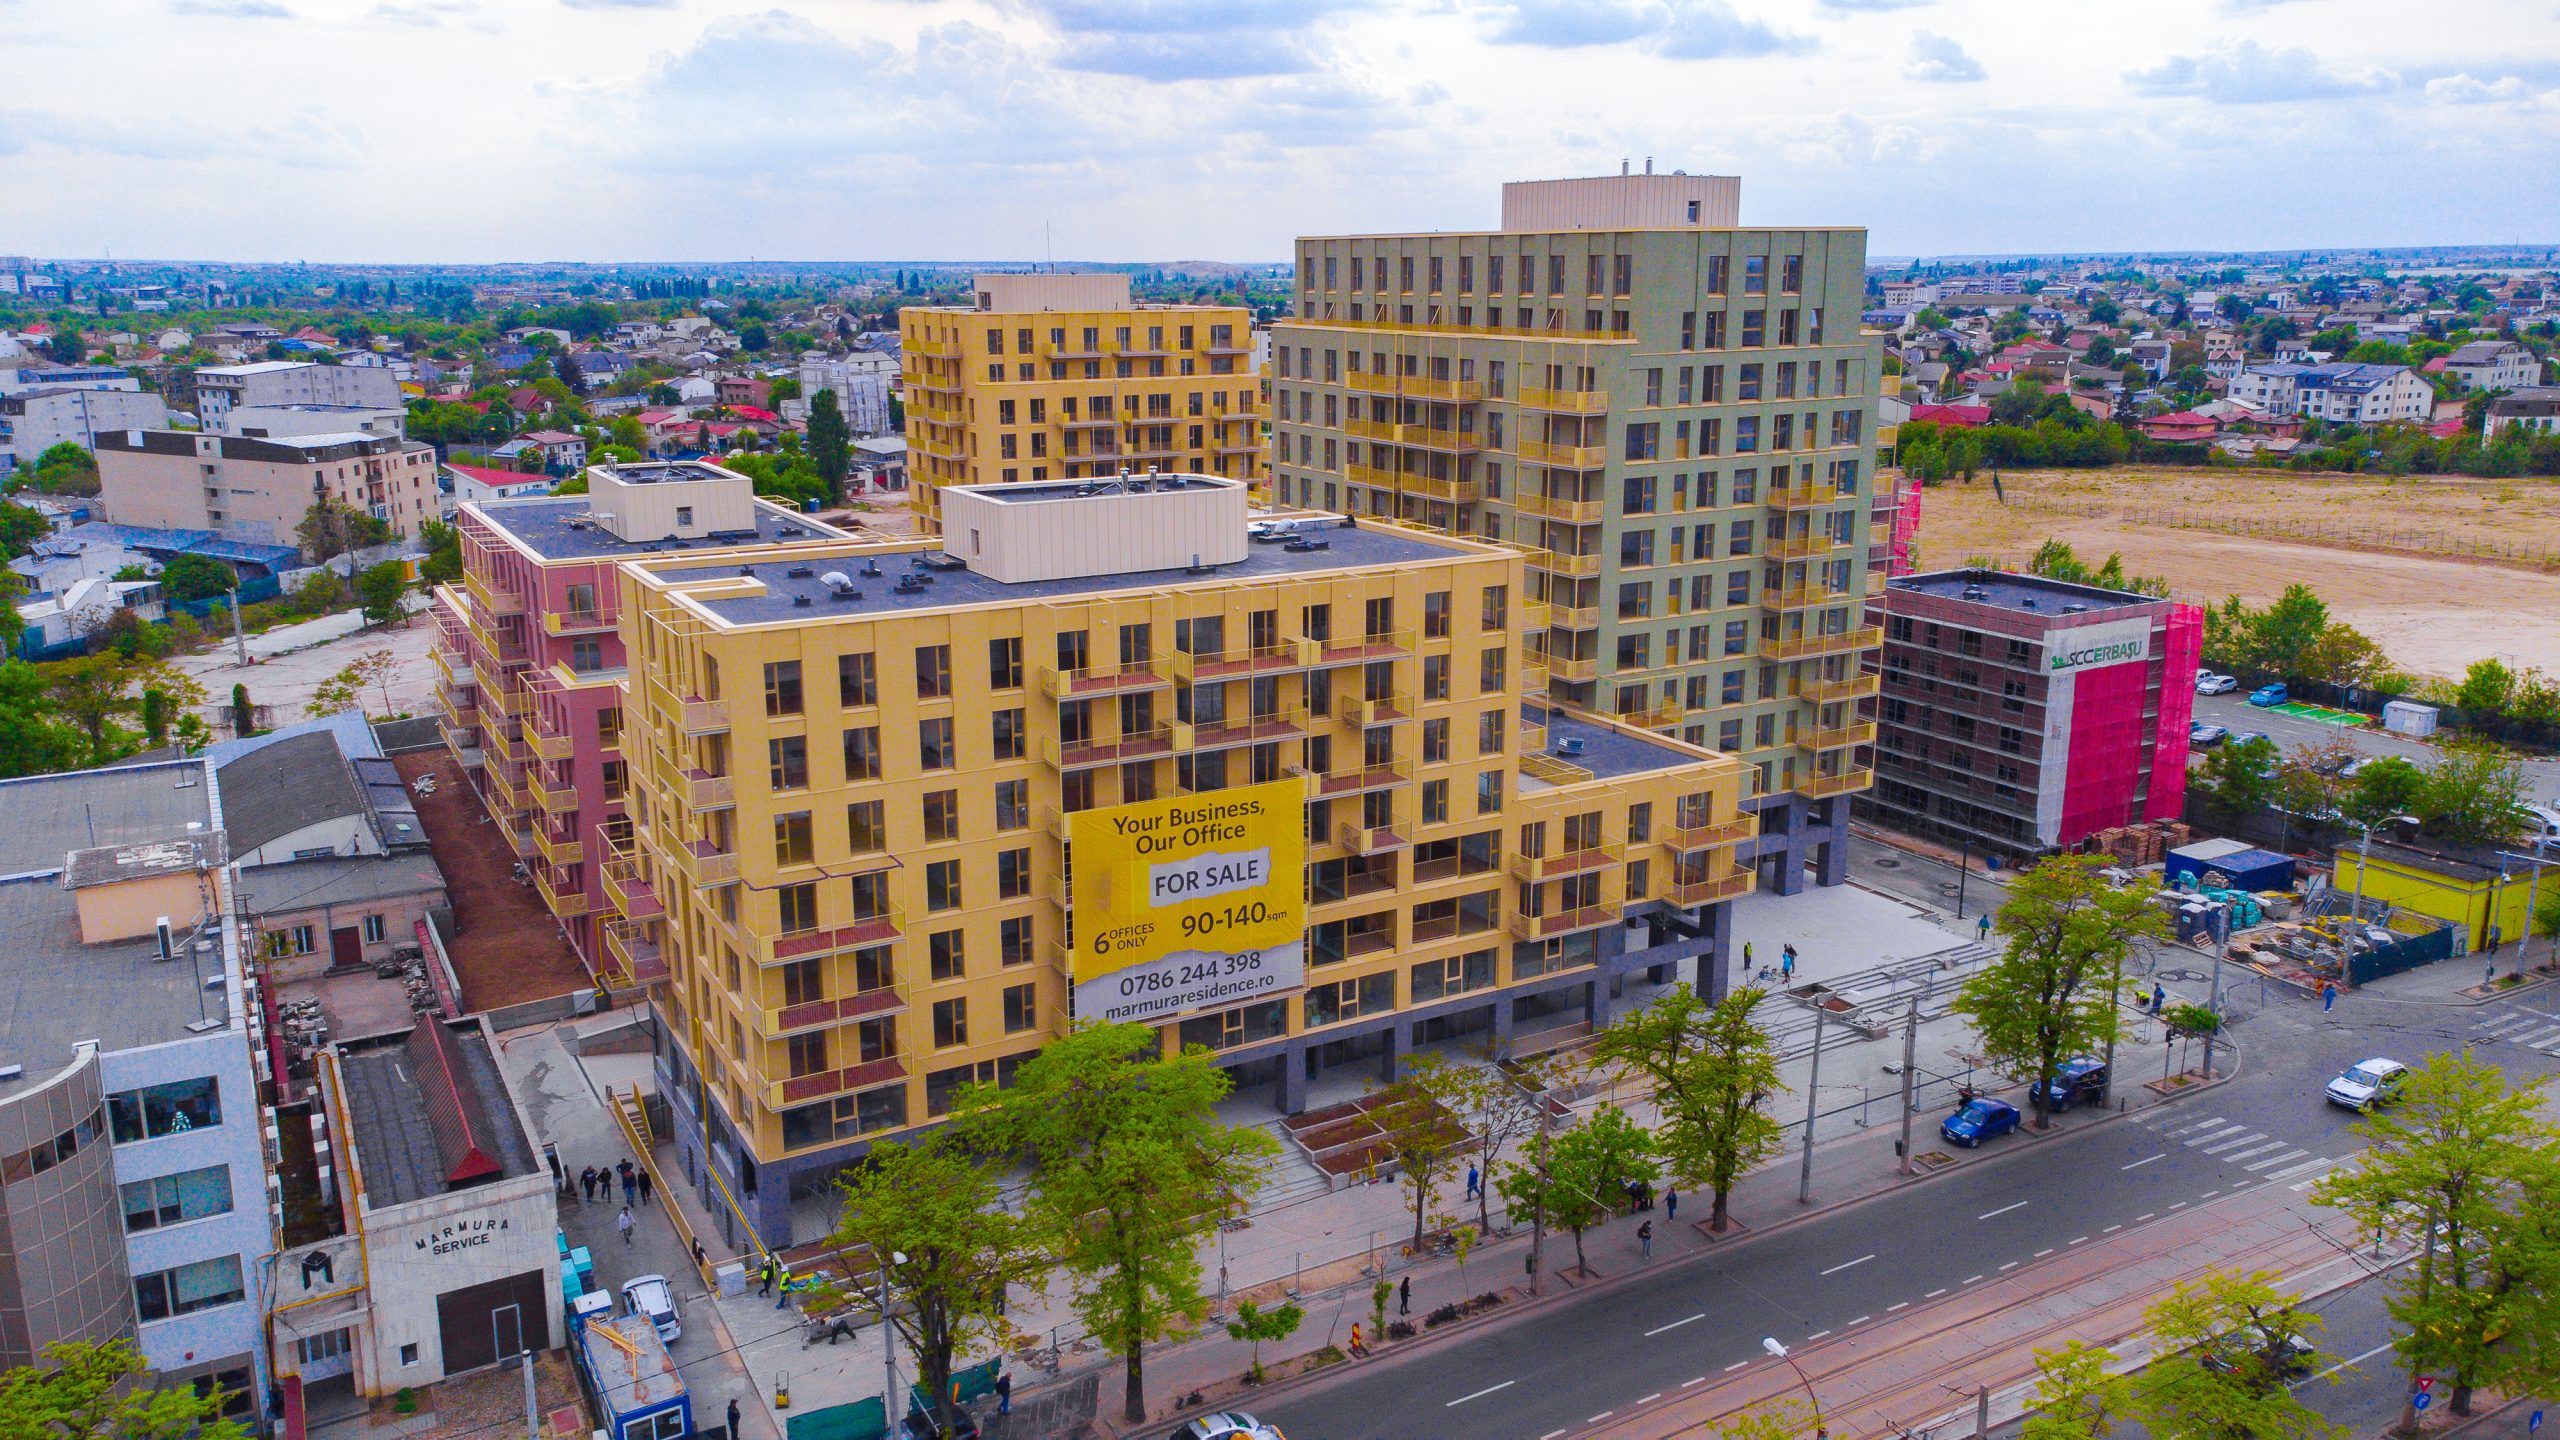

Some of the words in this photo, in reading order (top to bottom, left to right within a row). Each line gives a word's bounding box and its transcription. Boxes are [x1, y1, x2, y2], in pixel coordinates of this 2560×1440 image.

[1113, 814, 1163, 836] Your
[1169, 799, 1266, 828] Business,
[1136, 834, 1177, 854] Our
[1182, 822, 1246, 847] Office
[1155, 870, 1200, 897] FOR
[1205, 859, 1259, 888] SALE
[1181, 901, 1267, 938] 90-140
[1266, 909, 1288, 923] sqm
[1094, 931, 1110, 955] 6
[1109, 922, 1155, 940] OFFICES
[1117, 936, 1148, 951] ONLY
[1120, 970, 1174, 997] 0786
[1179, 960, 1219, 986] 244
[1224, 951, 1262, 976] 398
[1105, 974, 1275, 1019] marmuraresidence.ro
[415, 1219, 510, 1251] MARMURA
[432, 1233, 491, 1256] SERVICE
